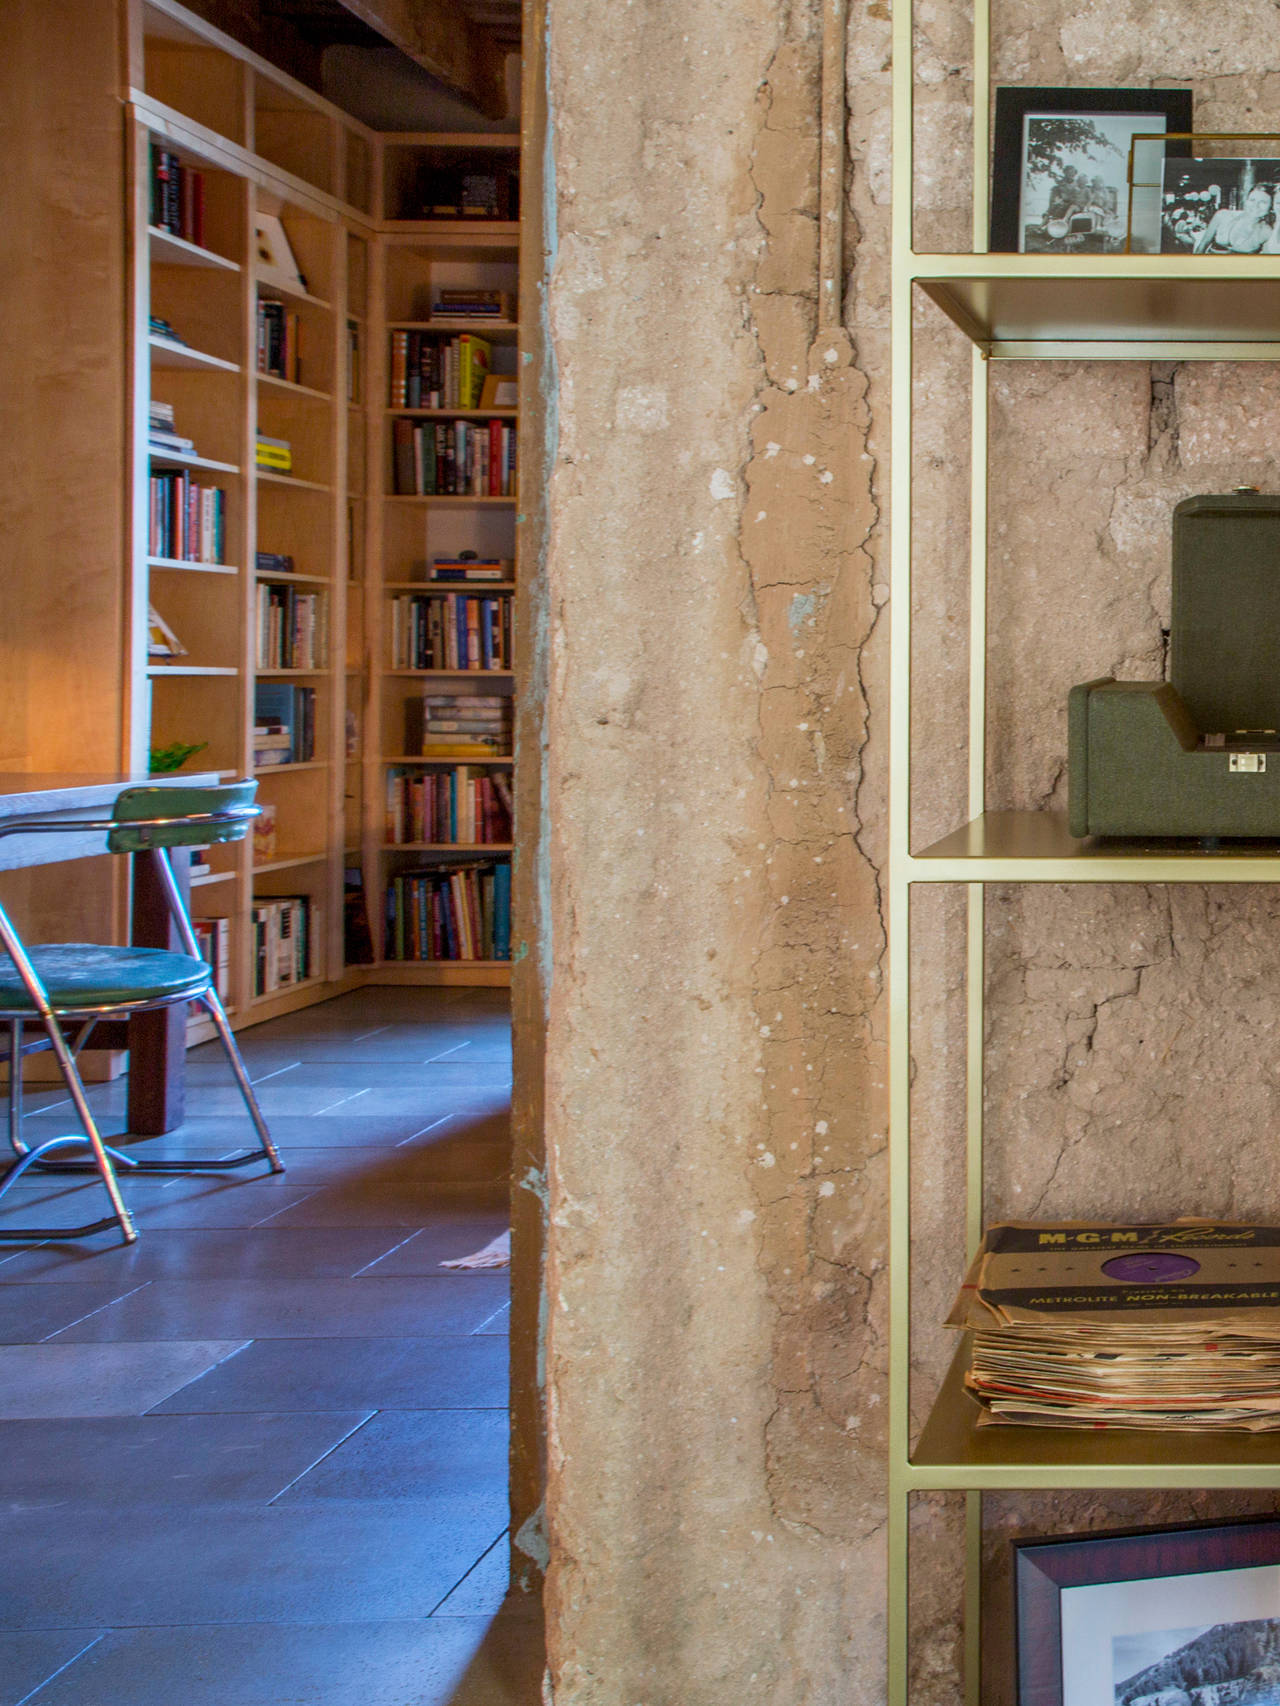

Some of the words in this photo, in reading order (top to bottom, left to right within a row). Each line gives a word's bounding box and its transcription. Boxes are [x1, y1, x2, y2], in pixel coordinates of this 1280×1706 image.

[1159, 1227, 1256, 1244] Records
[1029, 1295, 1119, 1304] METROLITE
[1126, 1291, 1280, 1302] NON-BREAKABLE
